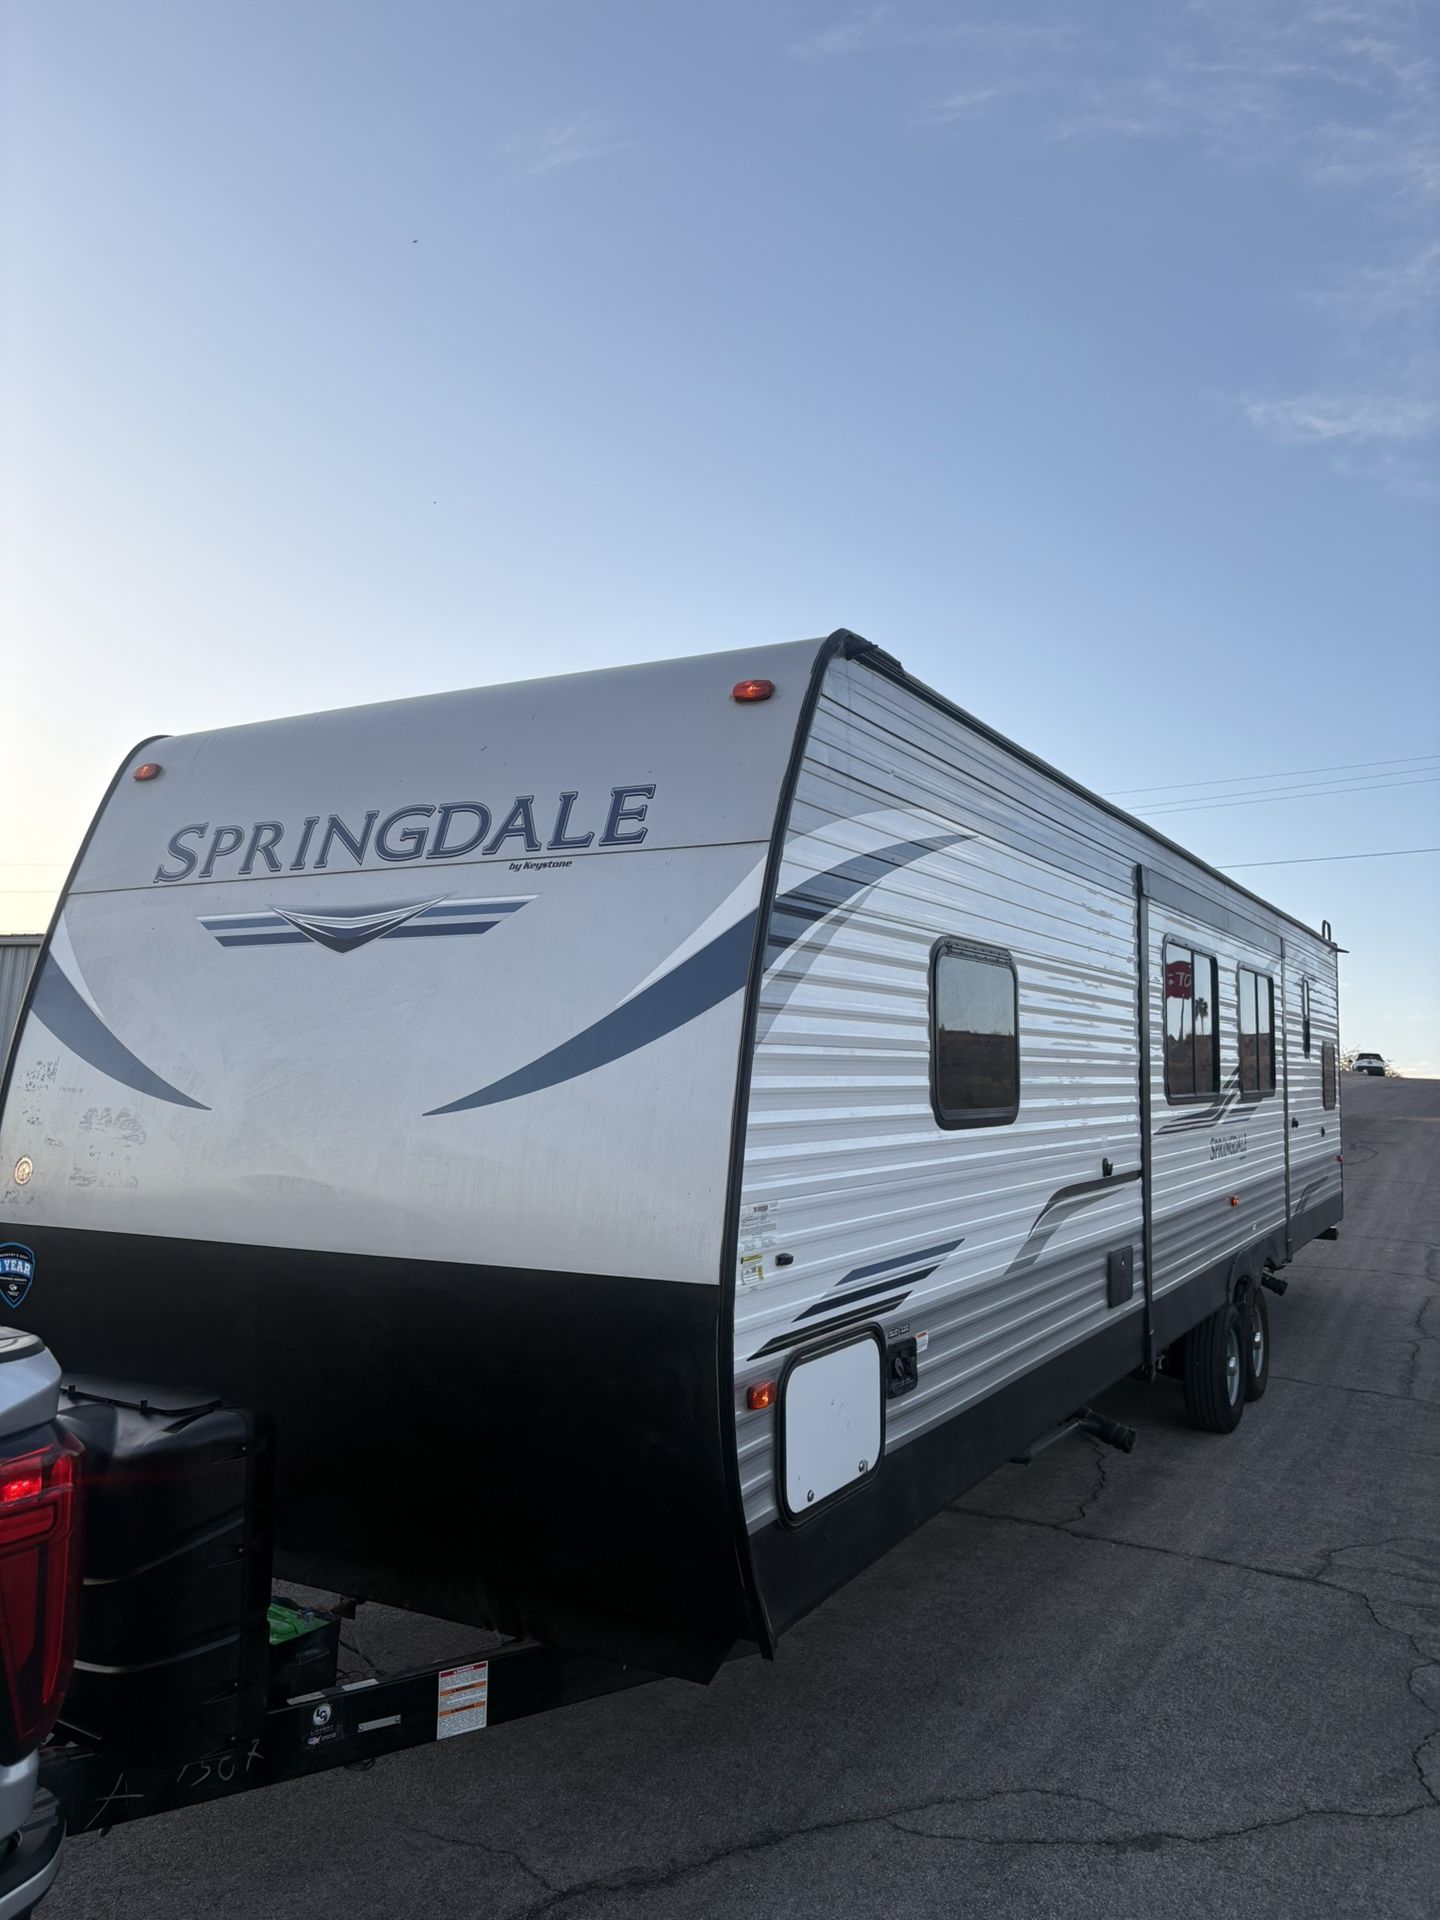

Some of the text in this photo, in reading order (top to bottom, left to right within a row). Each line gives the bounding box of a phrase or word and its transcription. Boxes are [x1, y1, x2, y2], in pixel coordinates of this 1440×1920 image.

[153, 784, 657, 883] SPRINGDALE
[509, 861, 573, 872] by Keystone
[4, 1259, 31, 1275] YEAR
